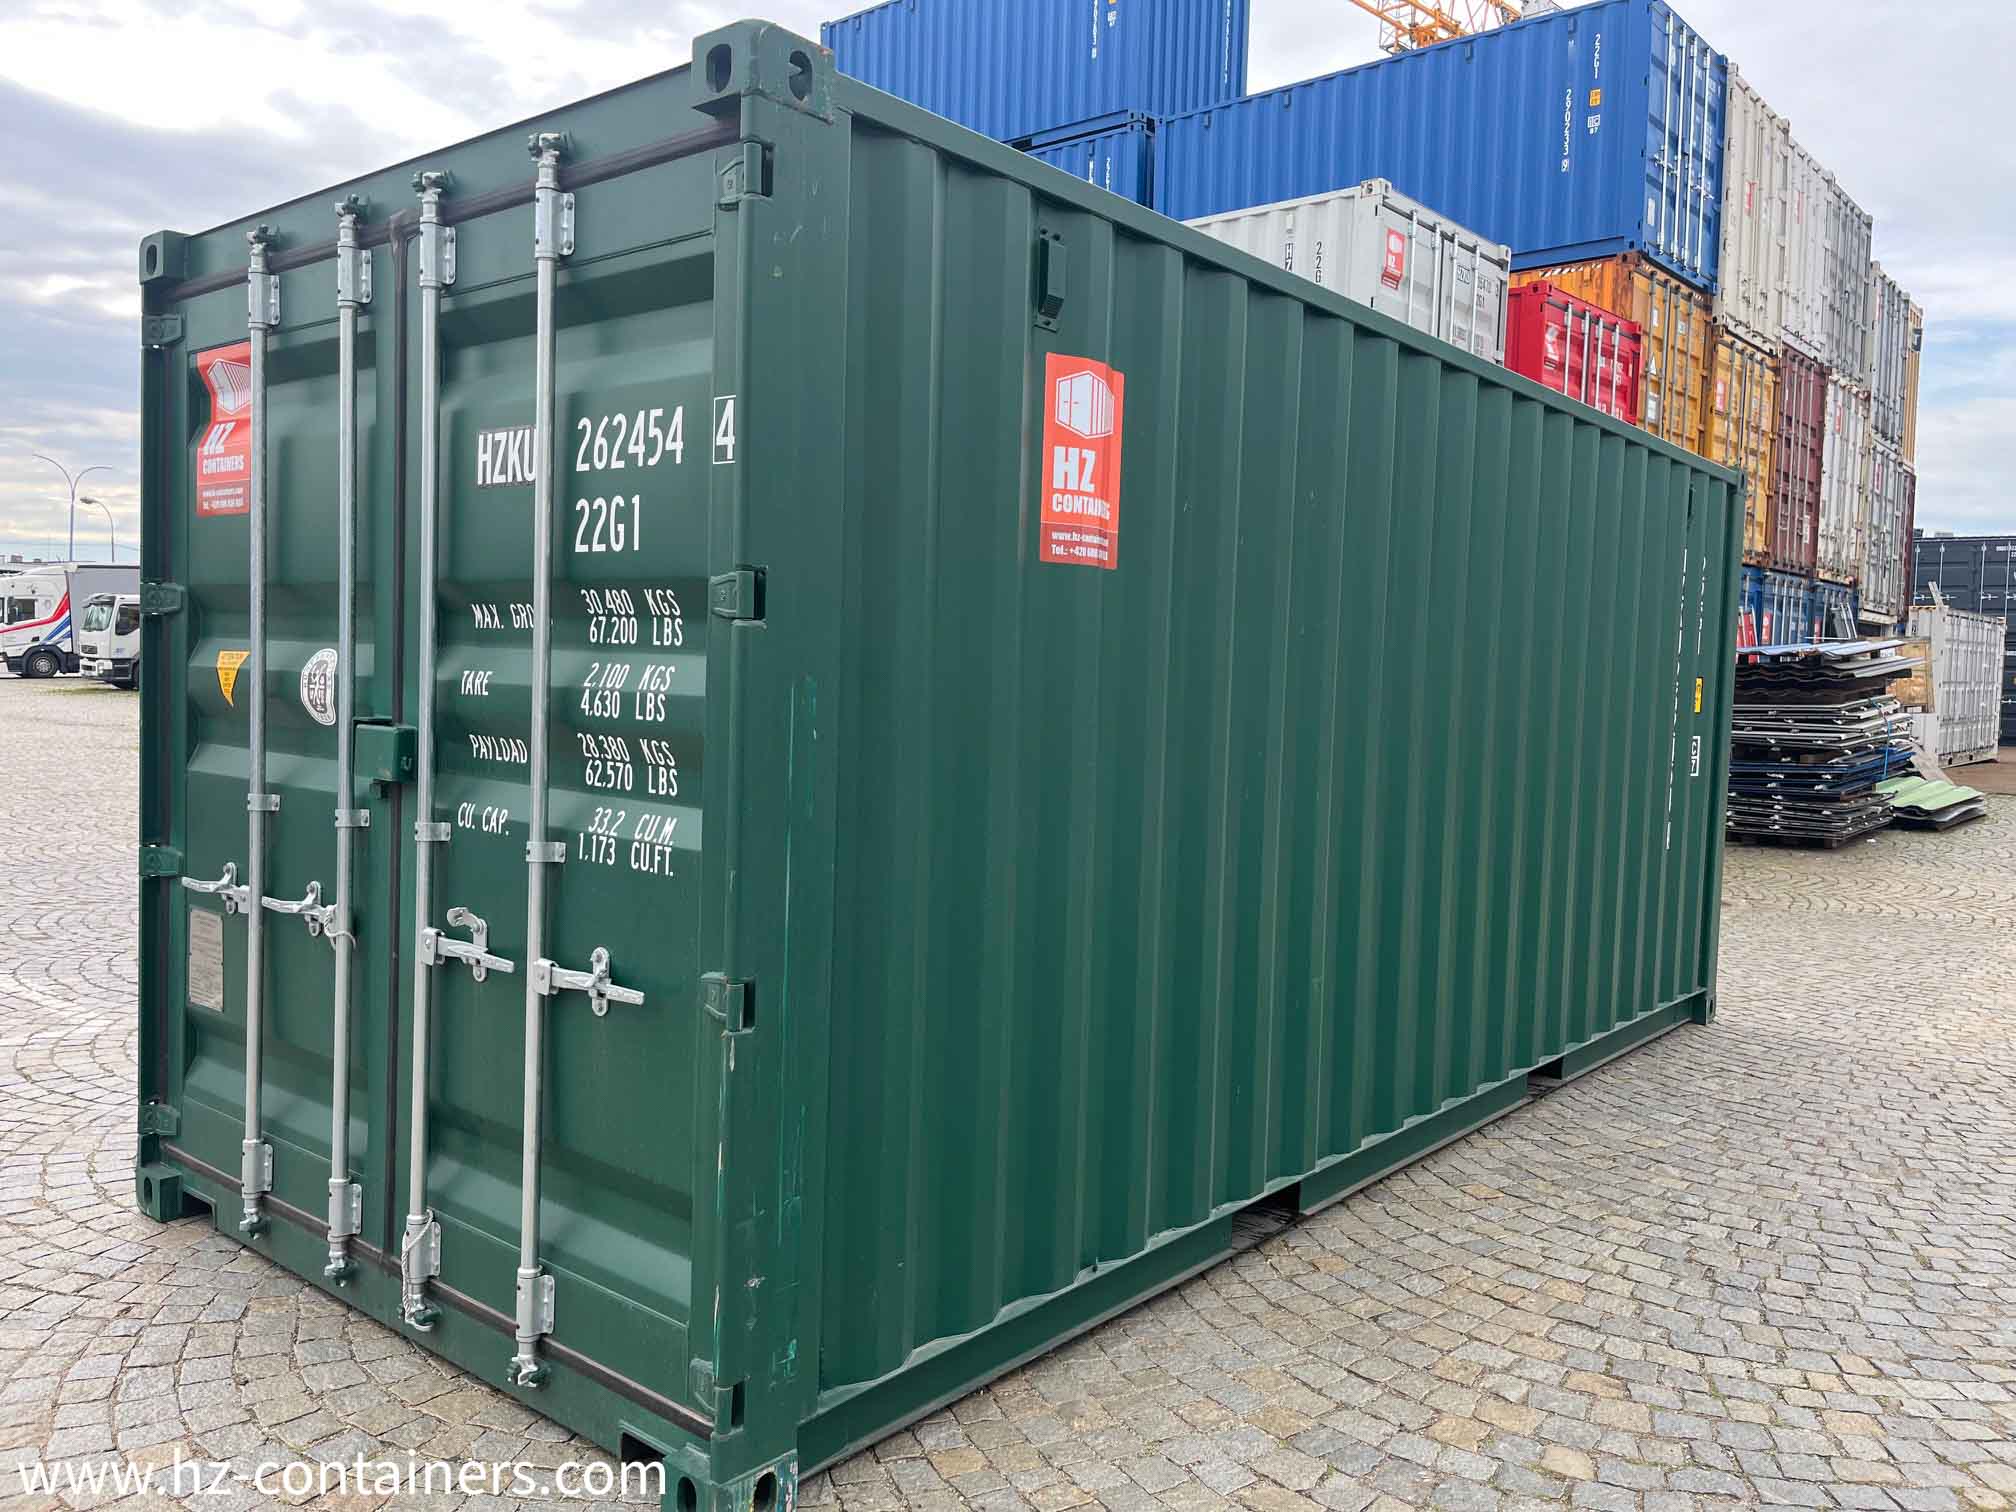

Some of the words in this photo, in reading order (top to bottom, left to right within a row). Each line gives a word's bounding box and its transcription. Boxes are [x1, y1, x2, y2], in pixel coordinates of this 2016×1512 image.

[203, 422, 236, 455] HZ
[477, 428, 536, 485] HZKU
[576, 405, 683, 472] 262454
[716, 399, 735, 460] 4
[1053, 446, 1096, 492] HZ
[575, 494, 640, 552] 22G1
[471, 603, 505, 629] MAX.
[644, 588, 681, 616] KGS
[589, 616, 638, 645] 67,200
[652, 617, 684, 646] LBS
[461, 670, 493, 696] TARE
[583, 662, 630, 690] 2,100
[638, 664, 676, 692] KGS
[580, 687, 621, 719] 4,630
[635, 691, 667, 723] LBS
[468, 734, 528, 764] PAYLOAD
[639, 738, 676, 768] KGS
[648, 765, 678, 797] LBS
[458, 802, 476, 830] CU.
[482, 806, 509, 836] CAP.
[588, 807, 626, 837] 33.2
[578, 831, 617, 866] 1,173
[631, 841, 674, 877] CU.FT.
